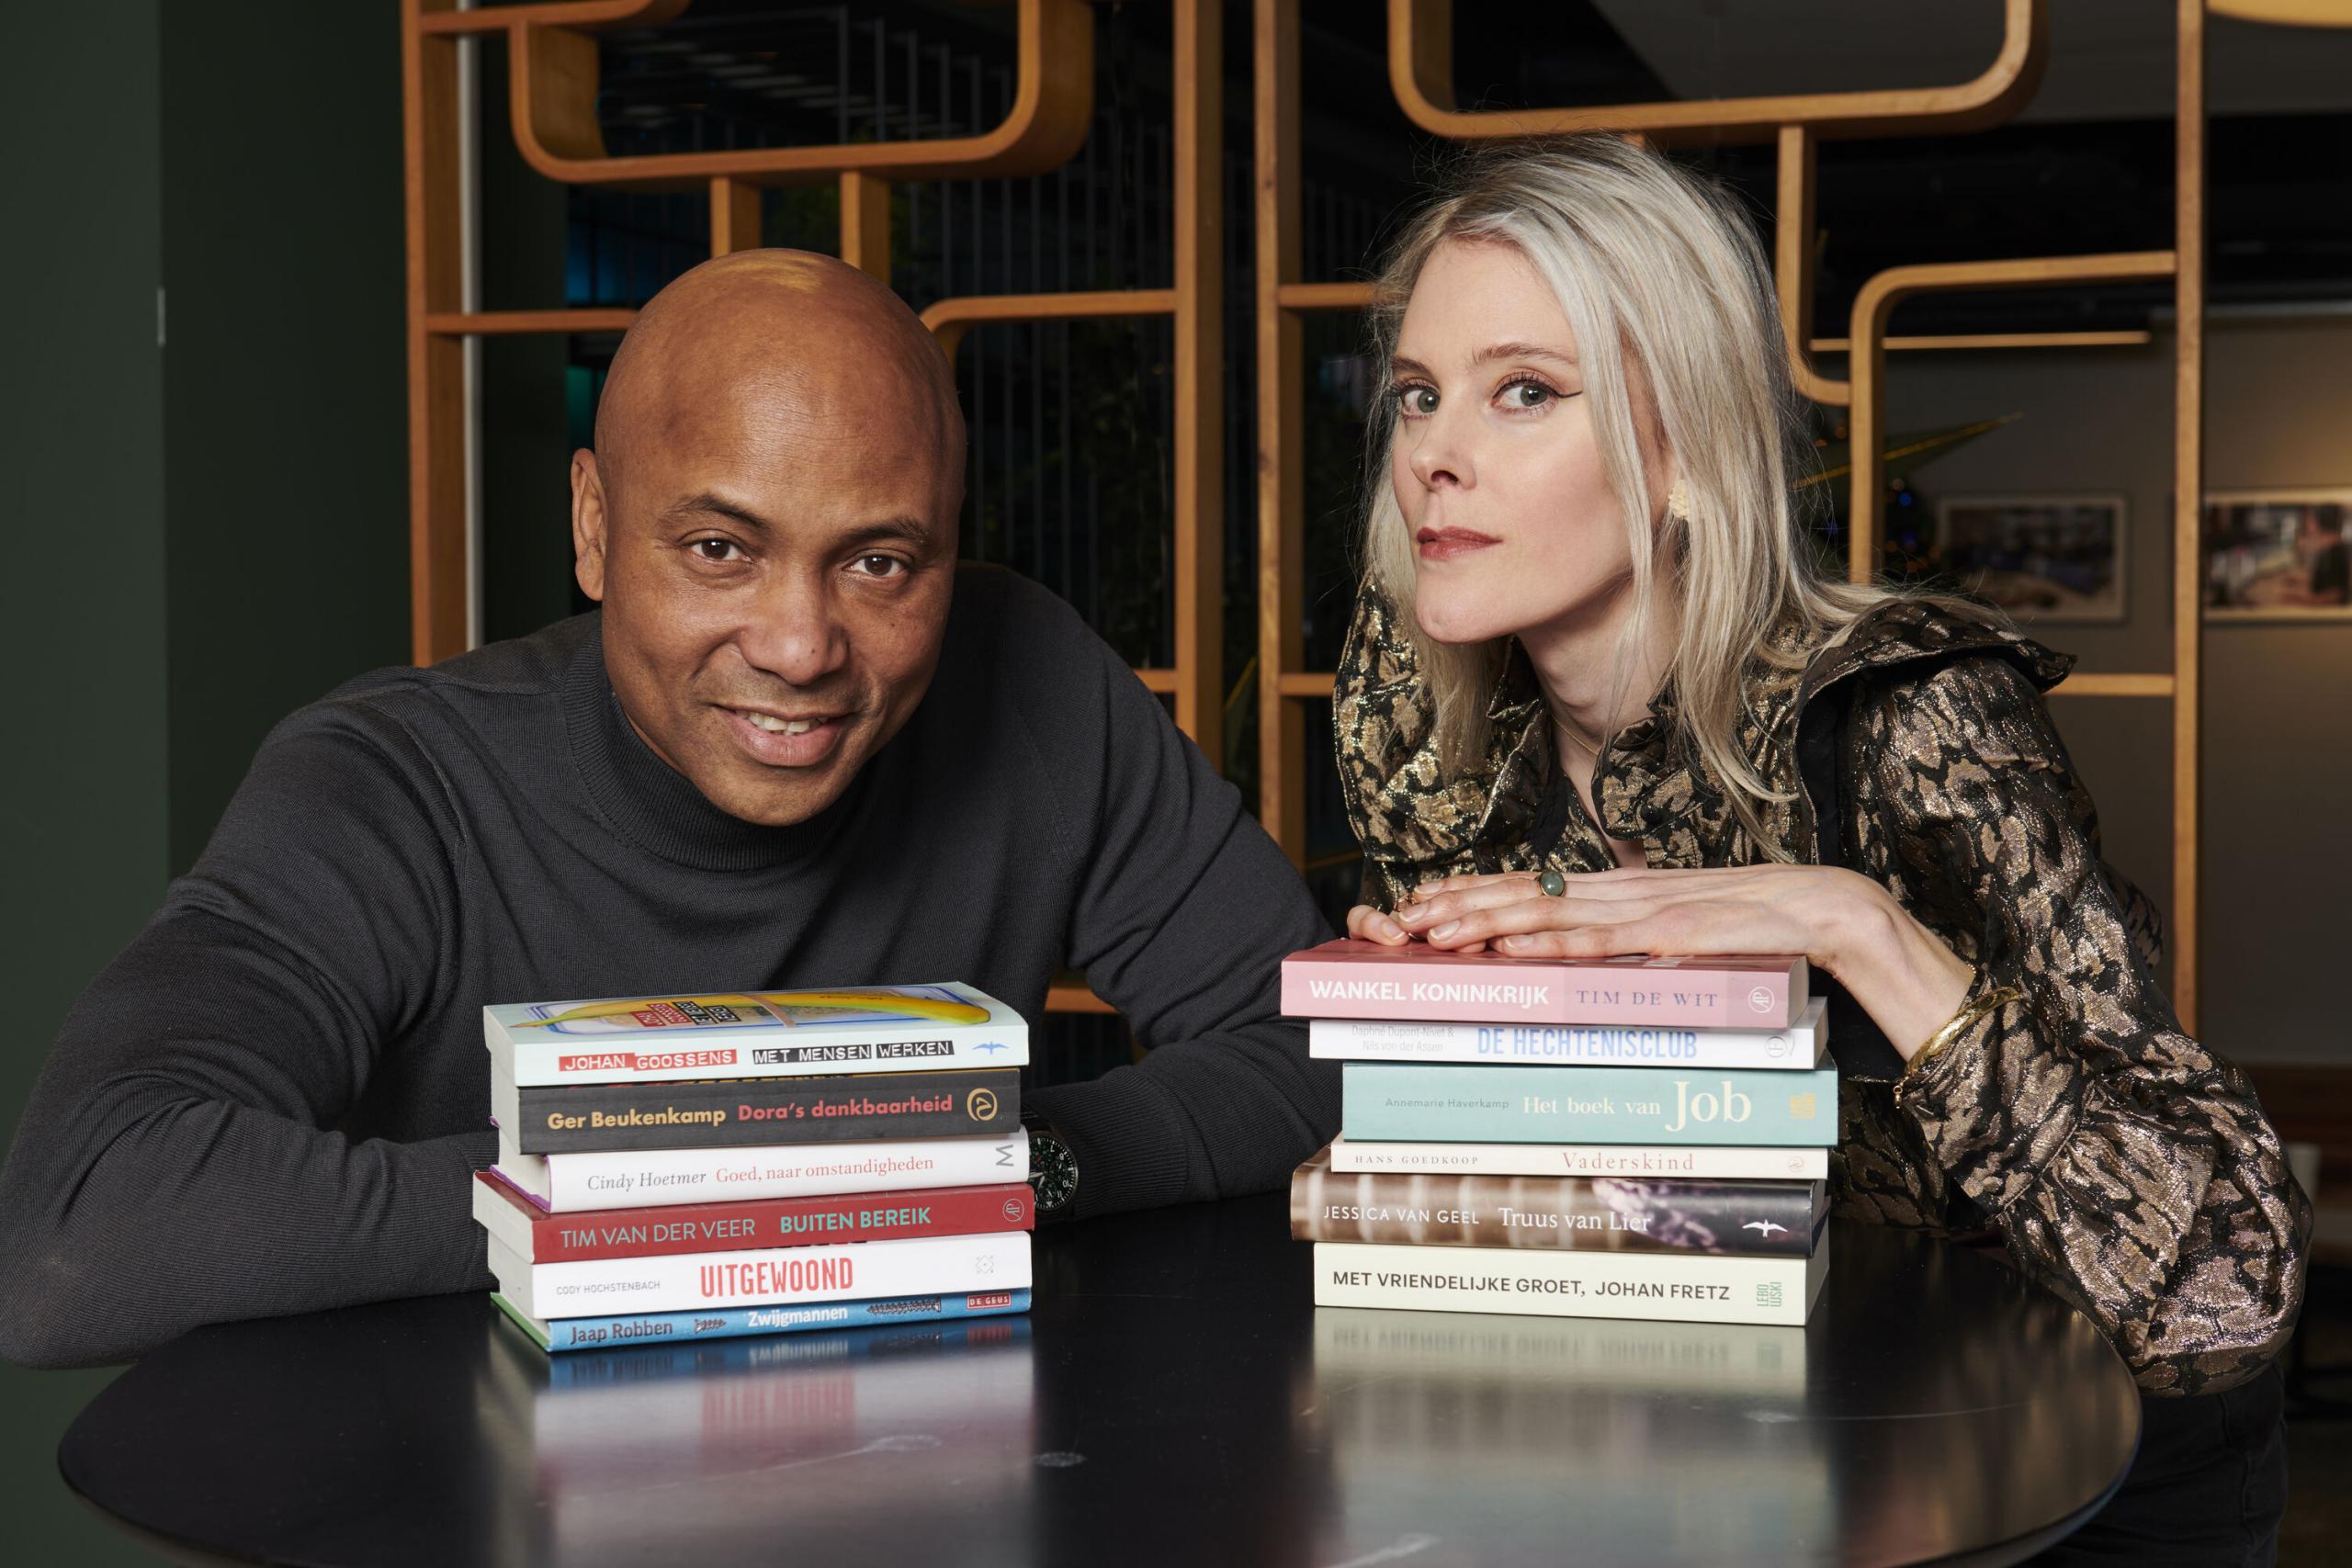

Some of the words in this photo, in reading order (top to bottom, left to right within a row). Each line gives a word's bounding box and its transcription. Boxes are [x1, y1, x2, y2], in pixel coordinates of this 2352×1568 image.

[1309, 980, 1406, 1000] WANKEL
[1413, 983, 1550, 1009] KONINKRIJK
[1577, 989, 1620, 1005] TIM
[1632, 992, 1661, 1006] DE
[1673, 992, 1718, 1007] WIT
[1477, 1027, 1505, 1055] DE
[1514, 1029, 1698, 1058] HECHTENISCLUB
[565, 1055, 626, 1071] JOHAN
[636, 1050, 732, 1069] GOOSSENS
[753, 1048, 791, 1064] MET
[799, 1045, 870, 1062] MENSEN
[878, 1042, 950, 1056] WERKEN
[548, 1112, 586, 1130] Ger
[592, 1107, 726, 1128] Beukenkamp
[739, 1103, 805, 1121] Dora's
[811, 1095, 953, 1117] dankbaarheid
[1385, 1099, 1444, 1108] Annemarie
[1523, 1097, 1558, 1113] Het
[1567, 1097, 1615, 1115] boek
[1625, 1101, 1661, 1115] van
[1665, 1080, 1752, 1132] Job
[1355, 1156, 1393, 1164] HANS
[1401, 1156, 1478, 1165] GOEDKOOP
[1562, 1152, 1694, 1170] Vaderskind
[588, 1174, 634, 1191] Cindy
[639, 1172, 707, 1187] Hoetmer
[717, 1165, 763, 1183] Goed,
[766, 1167, 802, 1179] naar
[806, 1157, 934, 1178] omstandigheden
[781, 1212, 854, 1234] BUITEN
[860, 1207, 932, 1228] BEREIK
[1324, 1205, 1389, 1221] JESSICA
[1396, 1209, 1430, 1224] VAN
[1437, 1210, 1479, 1224] GEEL
[1498, 1207, 1558, 1228] Truus
[1565, 1214, 1603, 1229] van
[1609, 1212, 1651, 1232] Lier
[560, 1229, 596, 1248] TIM
[602, 1225, 647, 1245] VAN
[654, 1223, 696, 1242] DER
[700, 1219, 755, 1238] VEER
[556, 1285, 581, 1295] CODY
[583, 1280, 661, 1293] HOCHSTENBACH
[700, 1257, 854, 1298] UITGEWOOND
[1333, 1271, 1372, 1286] MET
[1377, 1273, 1510, 1292] VRIENDELIJKE
[1516, 1278, 1586, 1297] GROET,
[1595, 1281, 1665, 1297] JOHAN
[1670, 1284, 1730, 1300] FRETZ
[969, 1298, 983, 1307] DE
[987, 1295, 1011, 1304] GEUS
[748, 1306, 848, 1328] Zwijgmannen
[570, 1326, 607, 1345] Jaap
[612, 1320, 673, 1339] Robben
